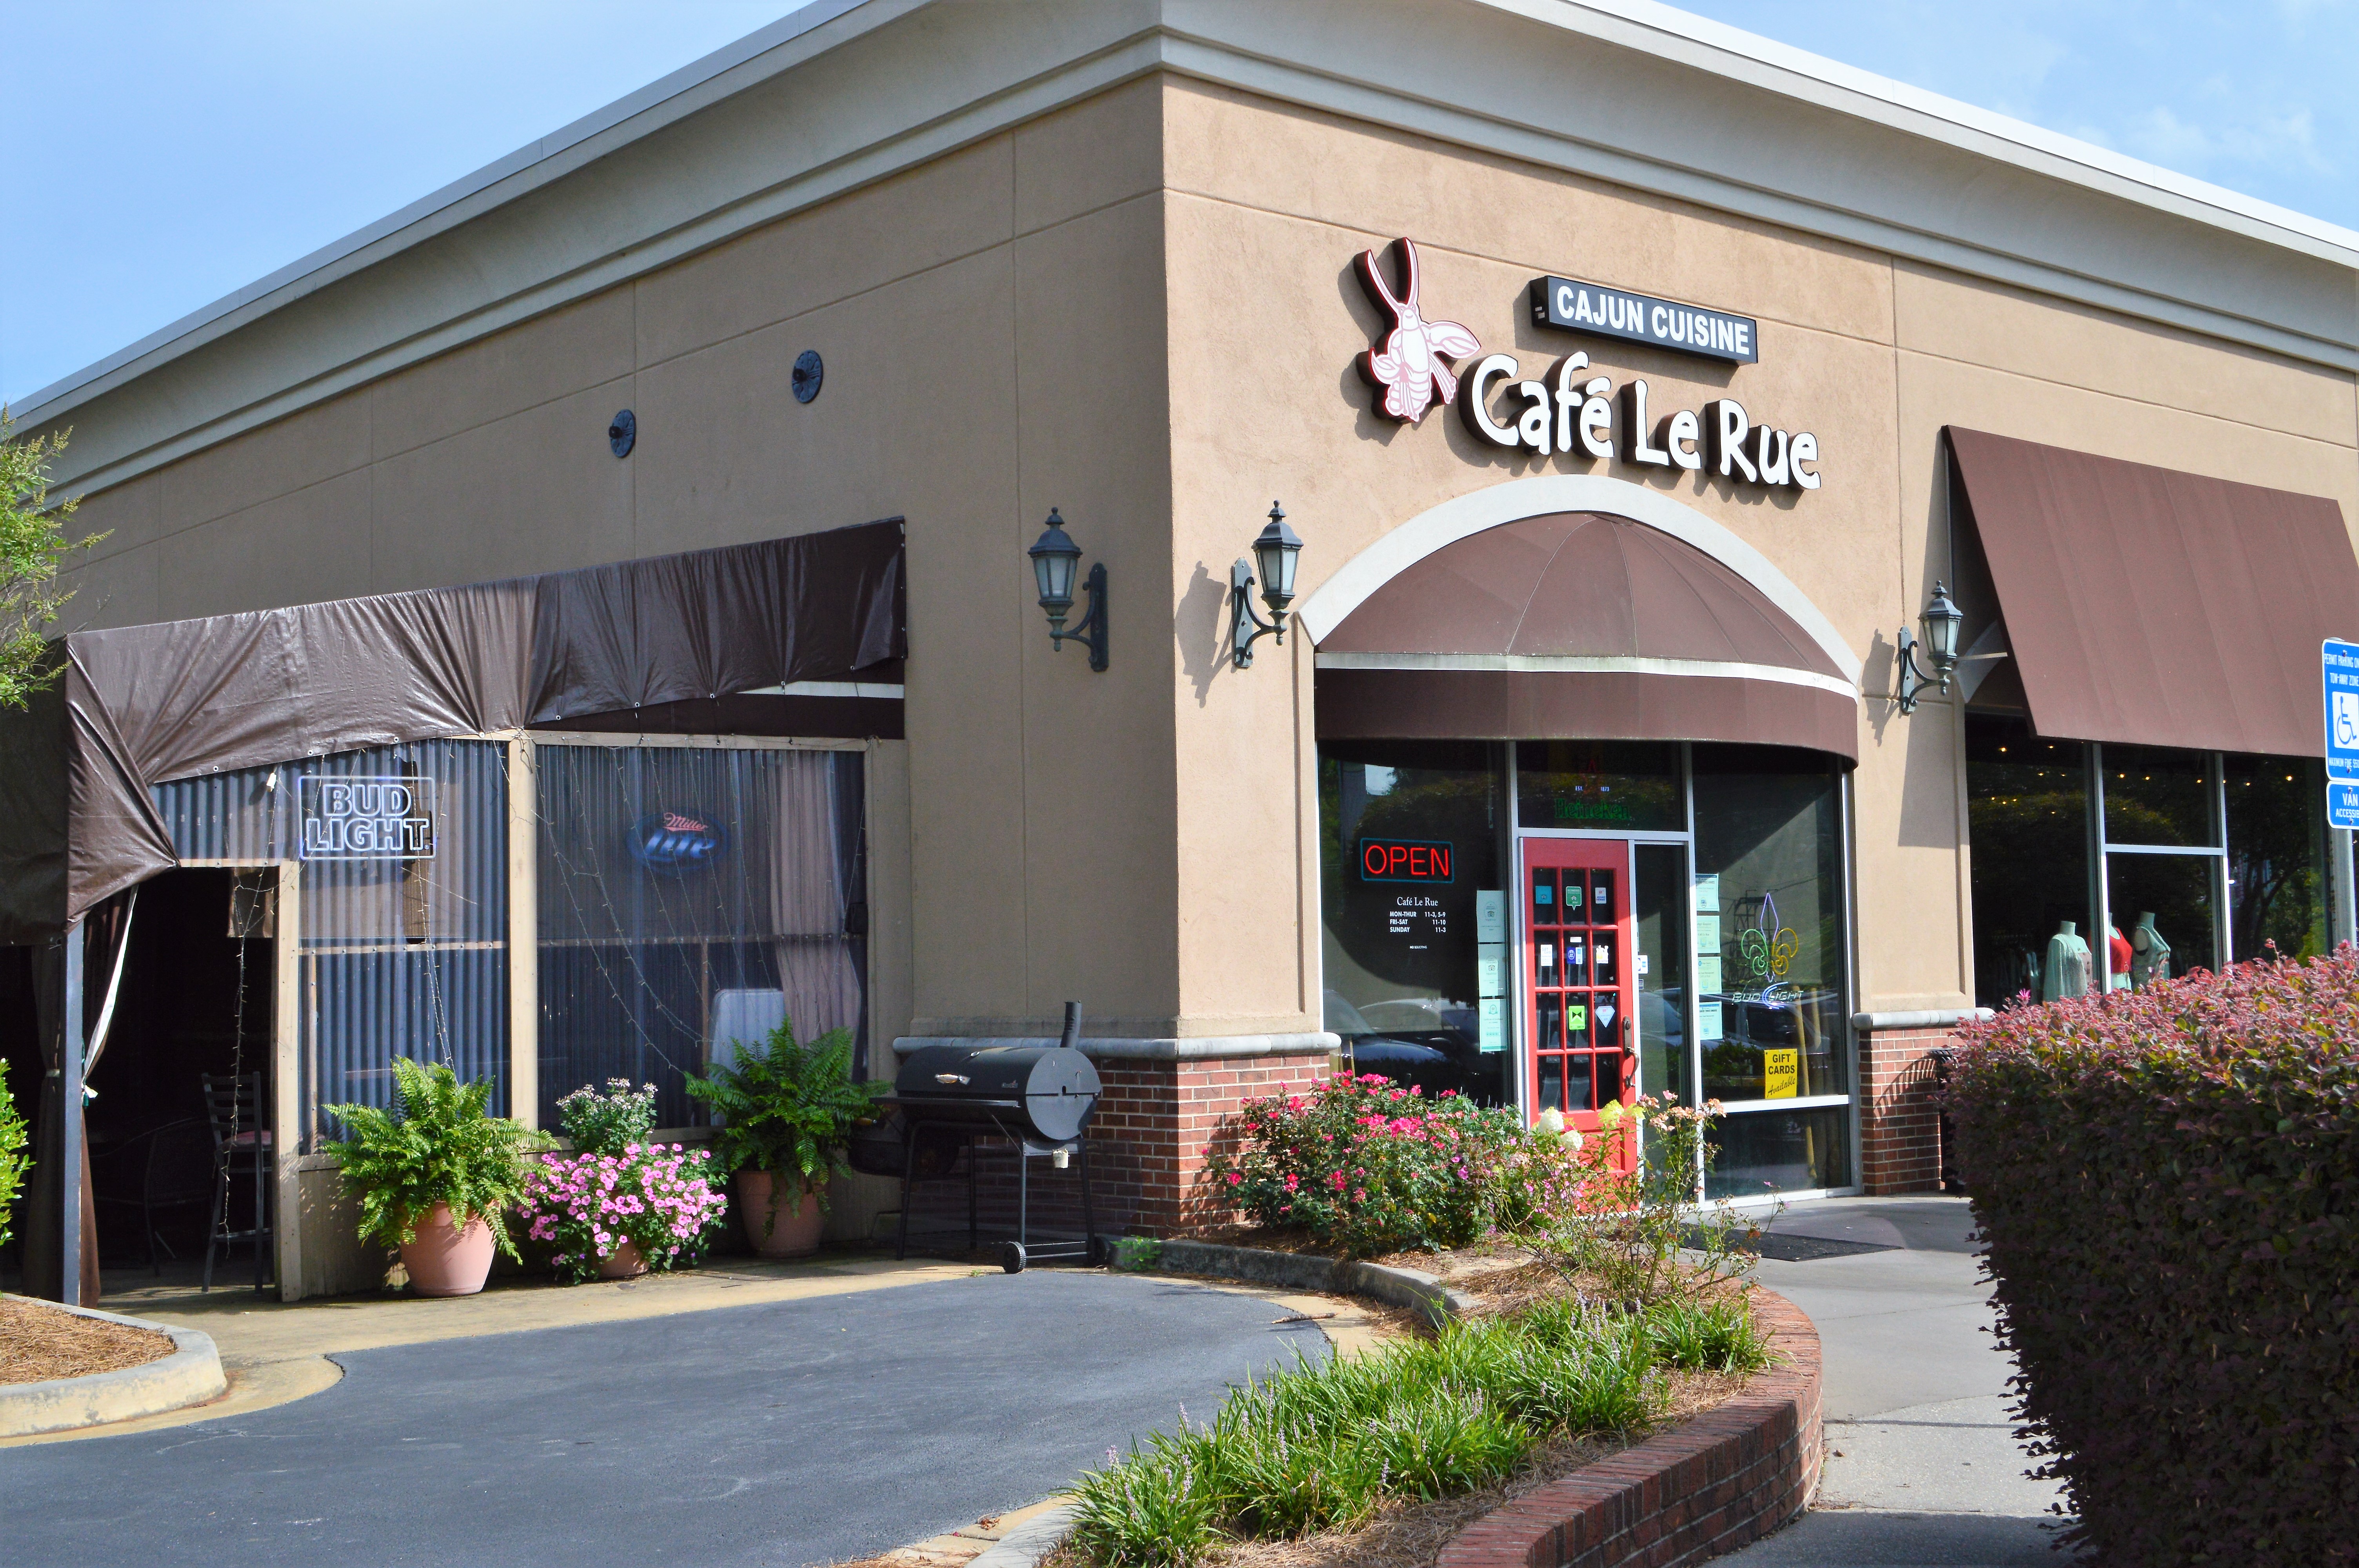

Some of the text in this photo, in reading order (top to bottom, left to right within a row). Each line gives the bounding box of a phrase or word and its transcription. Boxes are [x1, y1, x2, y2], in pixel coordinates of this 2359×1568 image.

[1557, 285, 1750, 356] CAJUN CUISINE
[1470, 351, 1821, 490] Café Le Rue
[2324, 653, 2337, 665] PERMIT
[2338, 655, 2354, 668] PARKING
[2330, 672, 2359, 687] TOW-AWAY ZONE
[2328, 757, 2344, 767] MAXIMUM
[2344, 758, 2352, 768] FINE
[323, 784, 412, 817] BUD
[2342, 793, 2358, 807] VAN
[1554, 798, 1630, 820] Heineken
[663, 812, 709, 830] Miller
[306, 818, 429, 851] LIGHT
[1365, 845, 1449, 877] OPEN
[1396, 897, 1438, 906] Café Le Rue
[1732, 990, 1804, 1002] BUD LIGHT
[1772, 1054, 1791, 1063] GIFT
[1768, 1065, 1795, 1075] CARDS
[1767, 1076, 1796, 1098] Available
